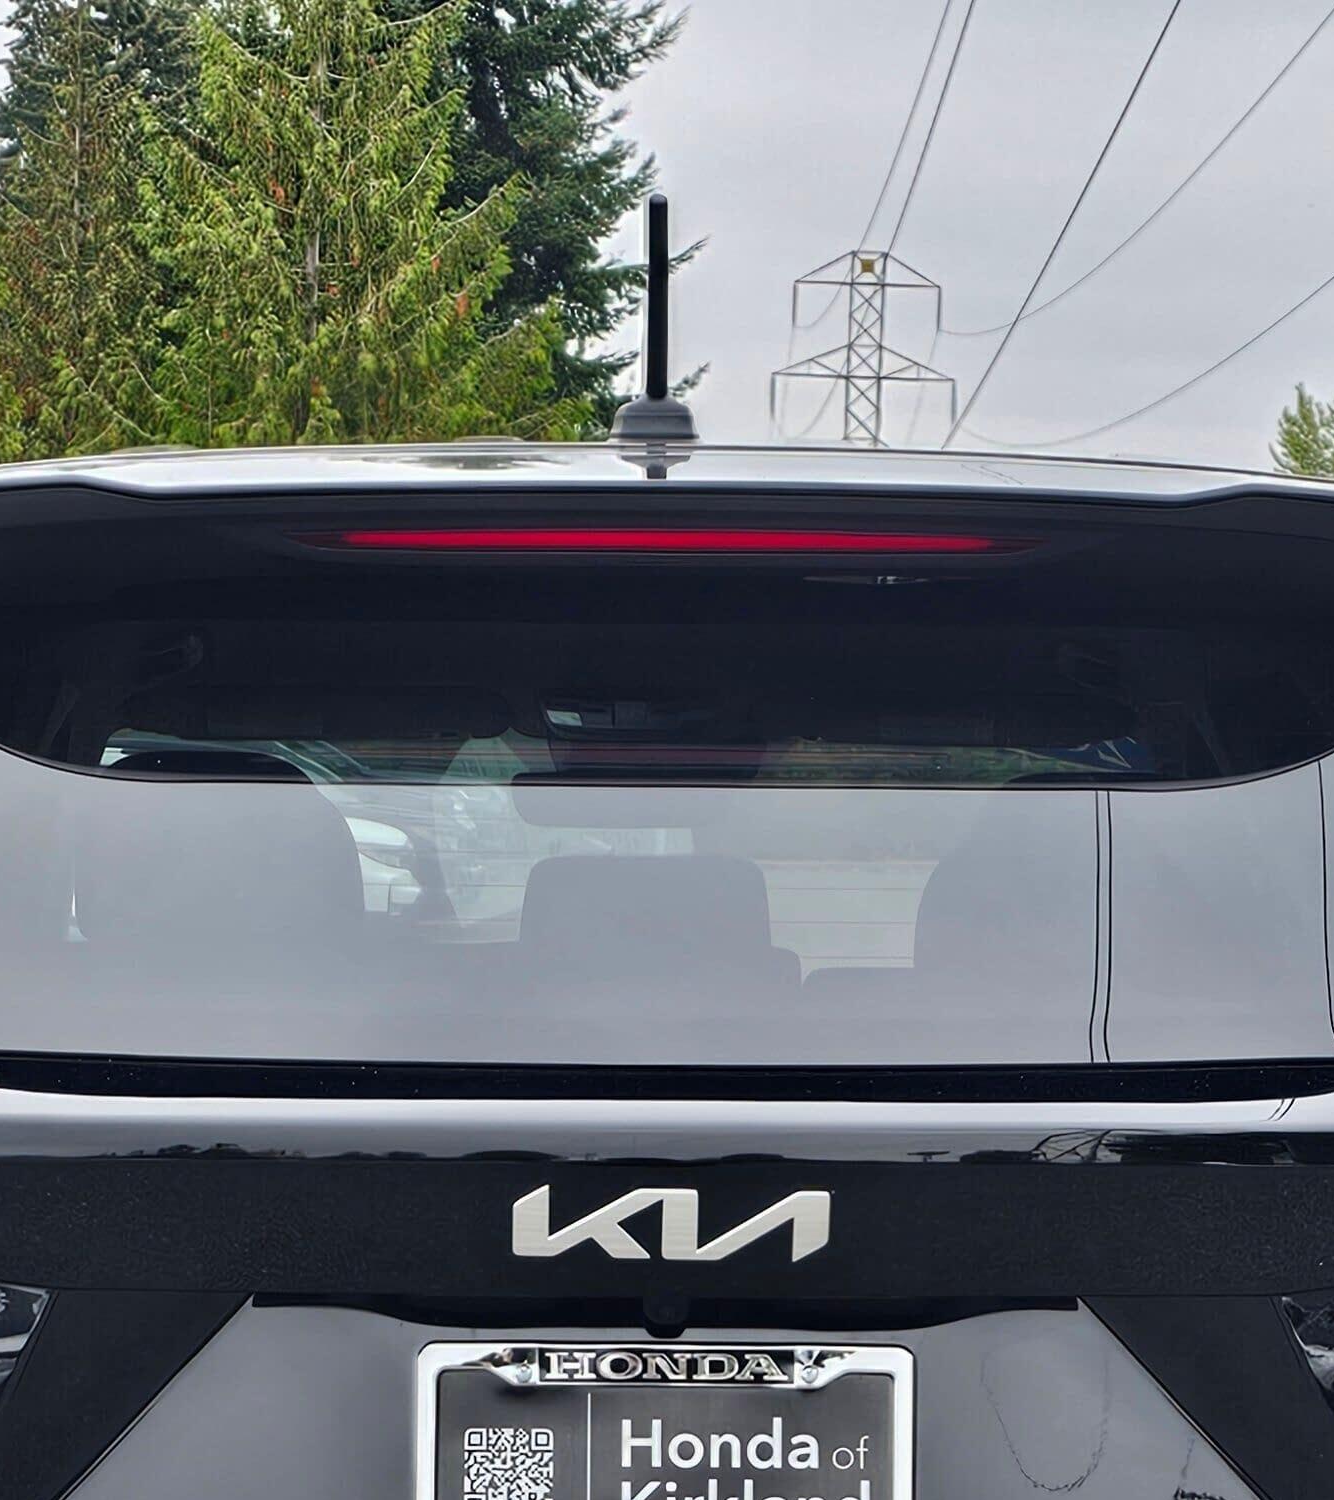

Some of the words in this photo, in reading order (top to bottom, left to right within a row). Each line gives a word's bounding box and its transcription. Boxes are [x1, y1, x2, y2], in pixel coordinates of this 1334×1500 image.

[511, 1184, 833, 1263] KIA
[544, 1351, 788, 1382] HONDA
[619, 1416, 820, 1470] Honda
[831, 1435, 870, 1470] of
